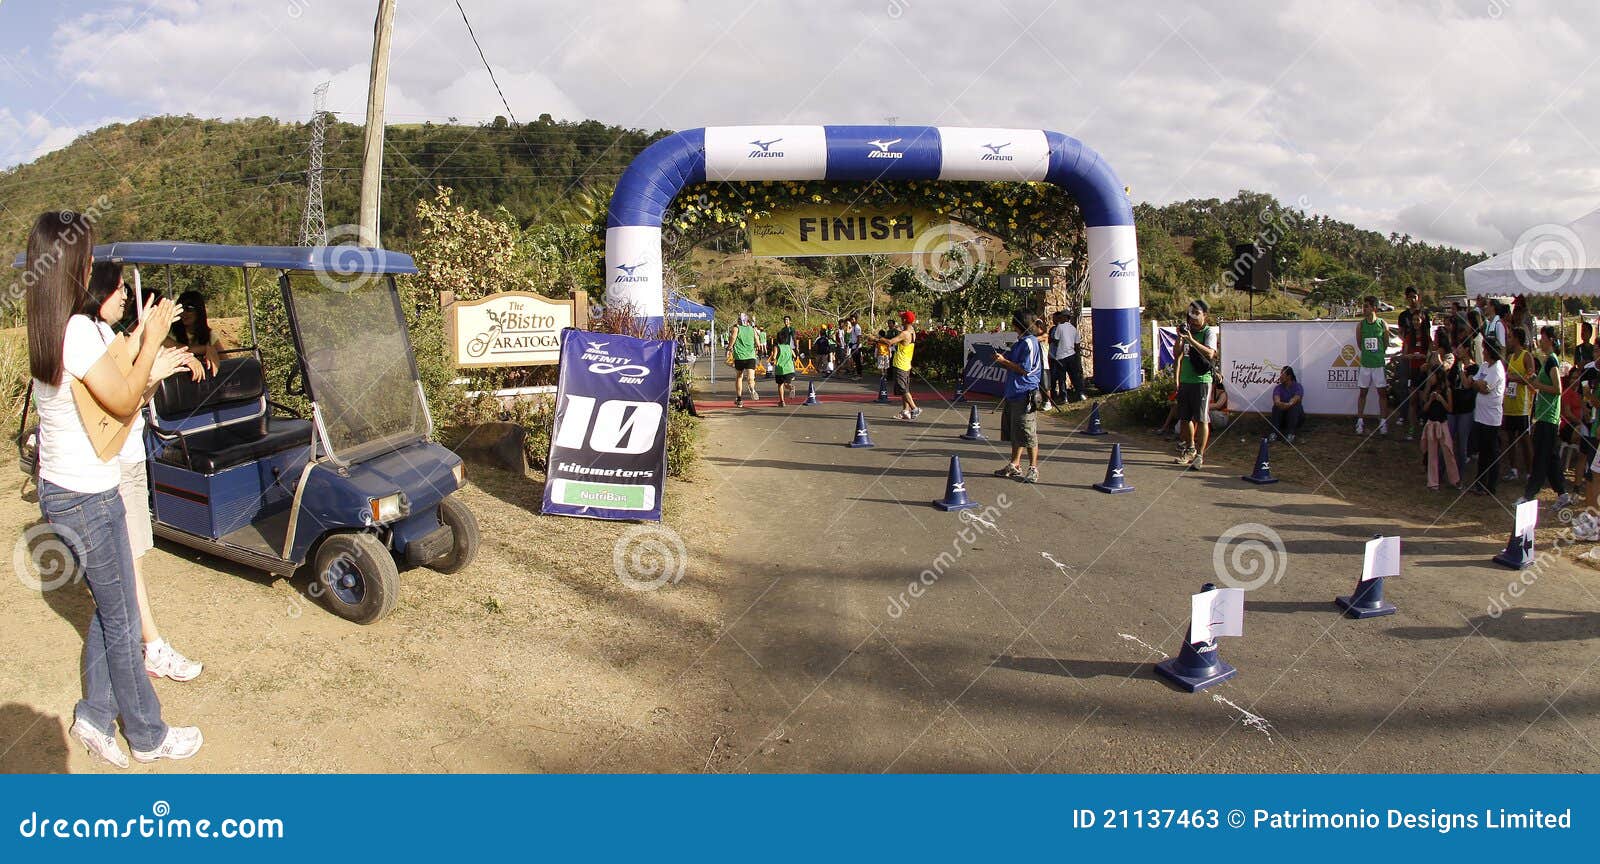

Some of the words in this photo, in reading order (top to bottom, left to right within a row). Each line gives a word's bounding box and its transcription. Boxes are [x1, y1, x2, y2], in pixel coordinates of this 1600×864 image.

[800, 215, 915, 242] FINISH
[508, 301, 525, 311] The
[506, 312, 555, 330] Bistro
[581, 352, 631, 365] INFINITY
[556, 394, 664, 455] 10
[558, 462, 655, 479] kilometers
